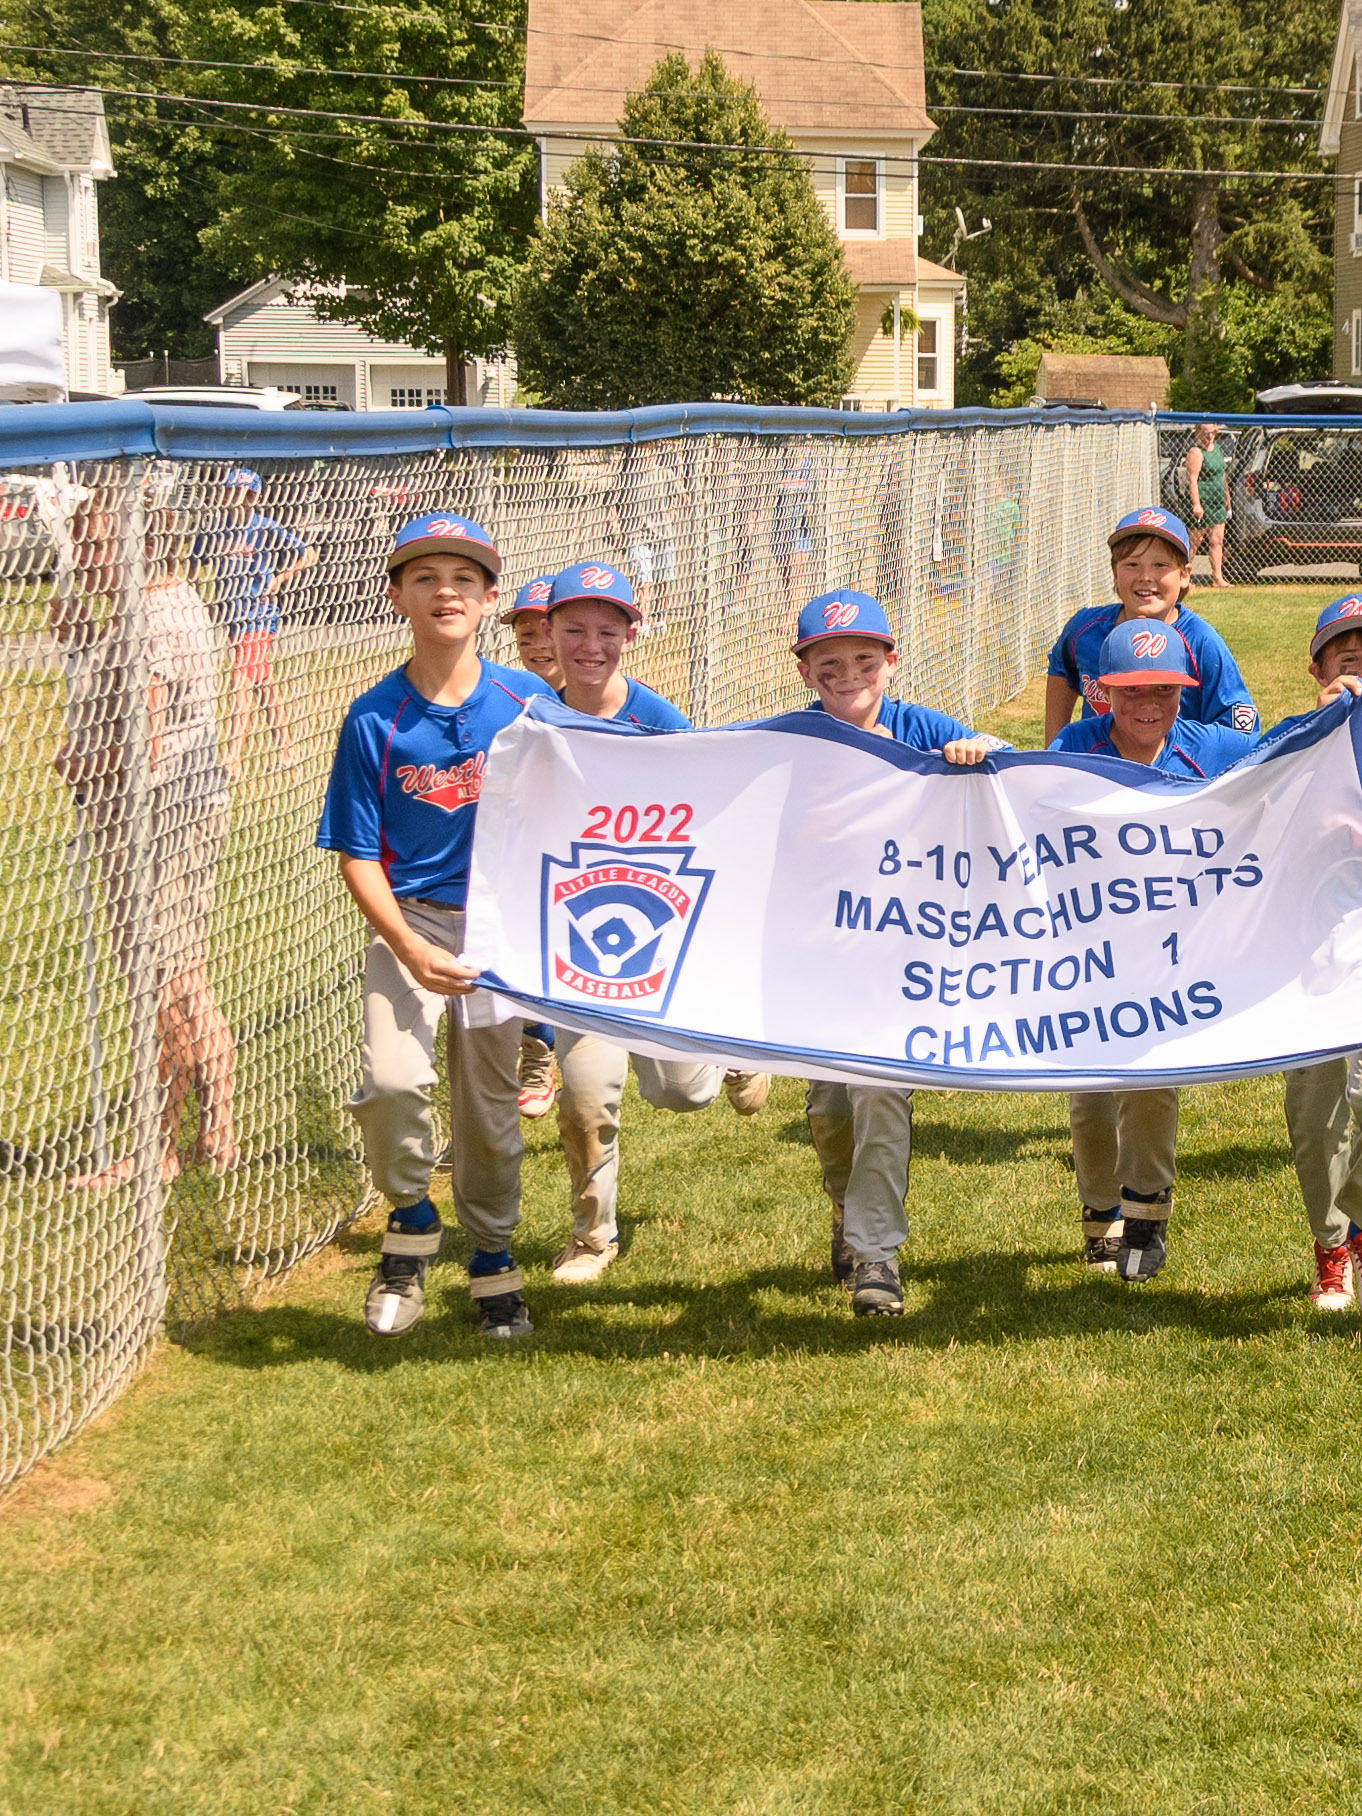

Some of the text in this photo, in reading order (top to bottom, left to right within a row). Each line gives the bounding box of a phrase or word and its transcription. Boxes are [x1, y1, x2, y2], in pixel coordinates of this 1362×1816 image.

[580, 566, 615, 589] W
[822, 601, 860, 629] W
[1131, 631, 1167, 659] W
[580, 803, 694, 843] 2022
[878, 822, 1225, 888] 8-10 YEAR OLD
[558, 868, 687, 908] LITTLE LEAGUE
[834, 853, 1264, 948] MASSACHUSETTS
[561, 969, 655, 998] BASEBALL
[901, 932, 1180, 1007] SECTION 1
[904, 980, 1223, 1065] CHAMPIONS
